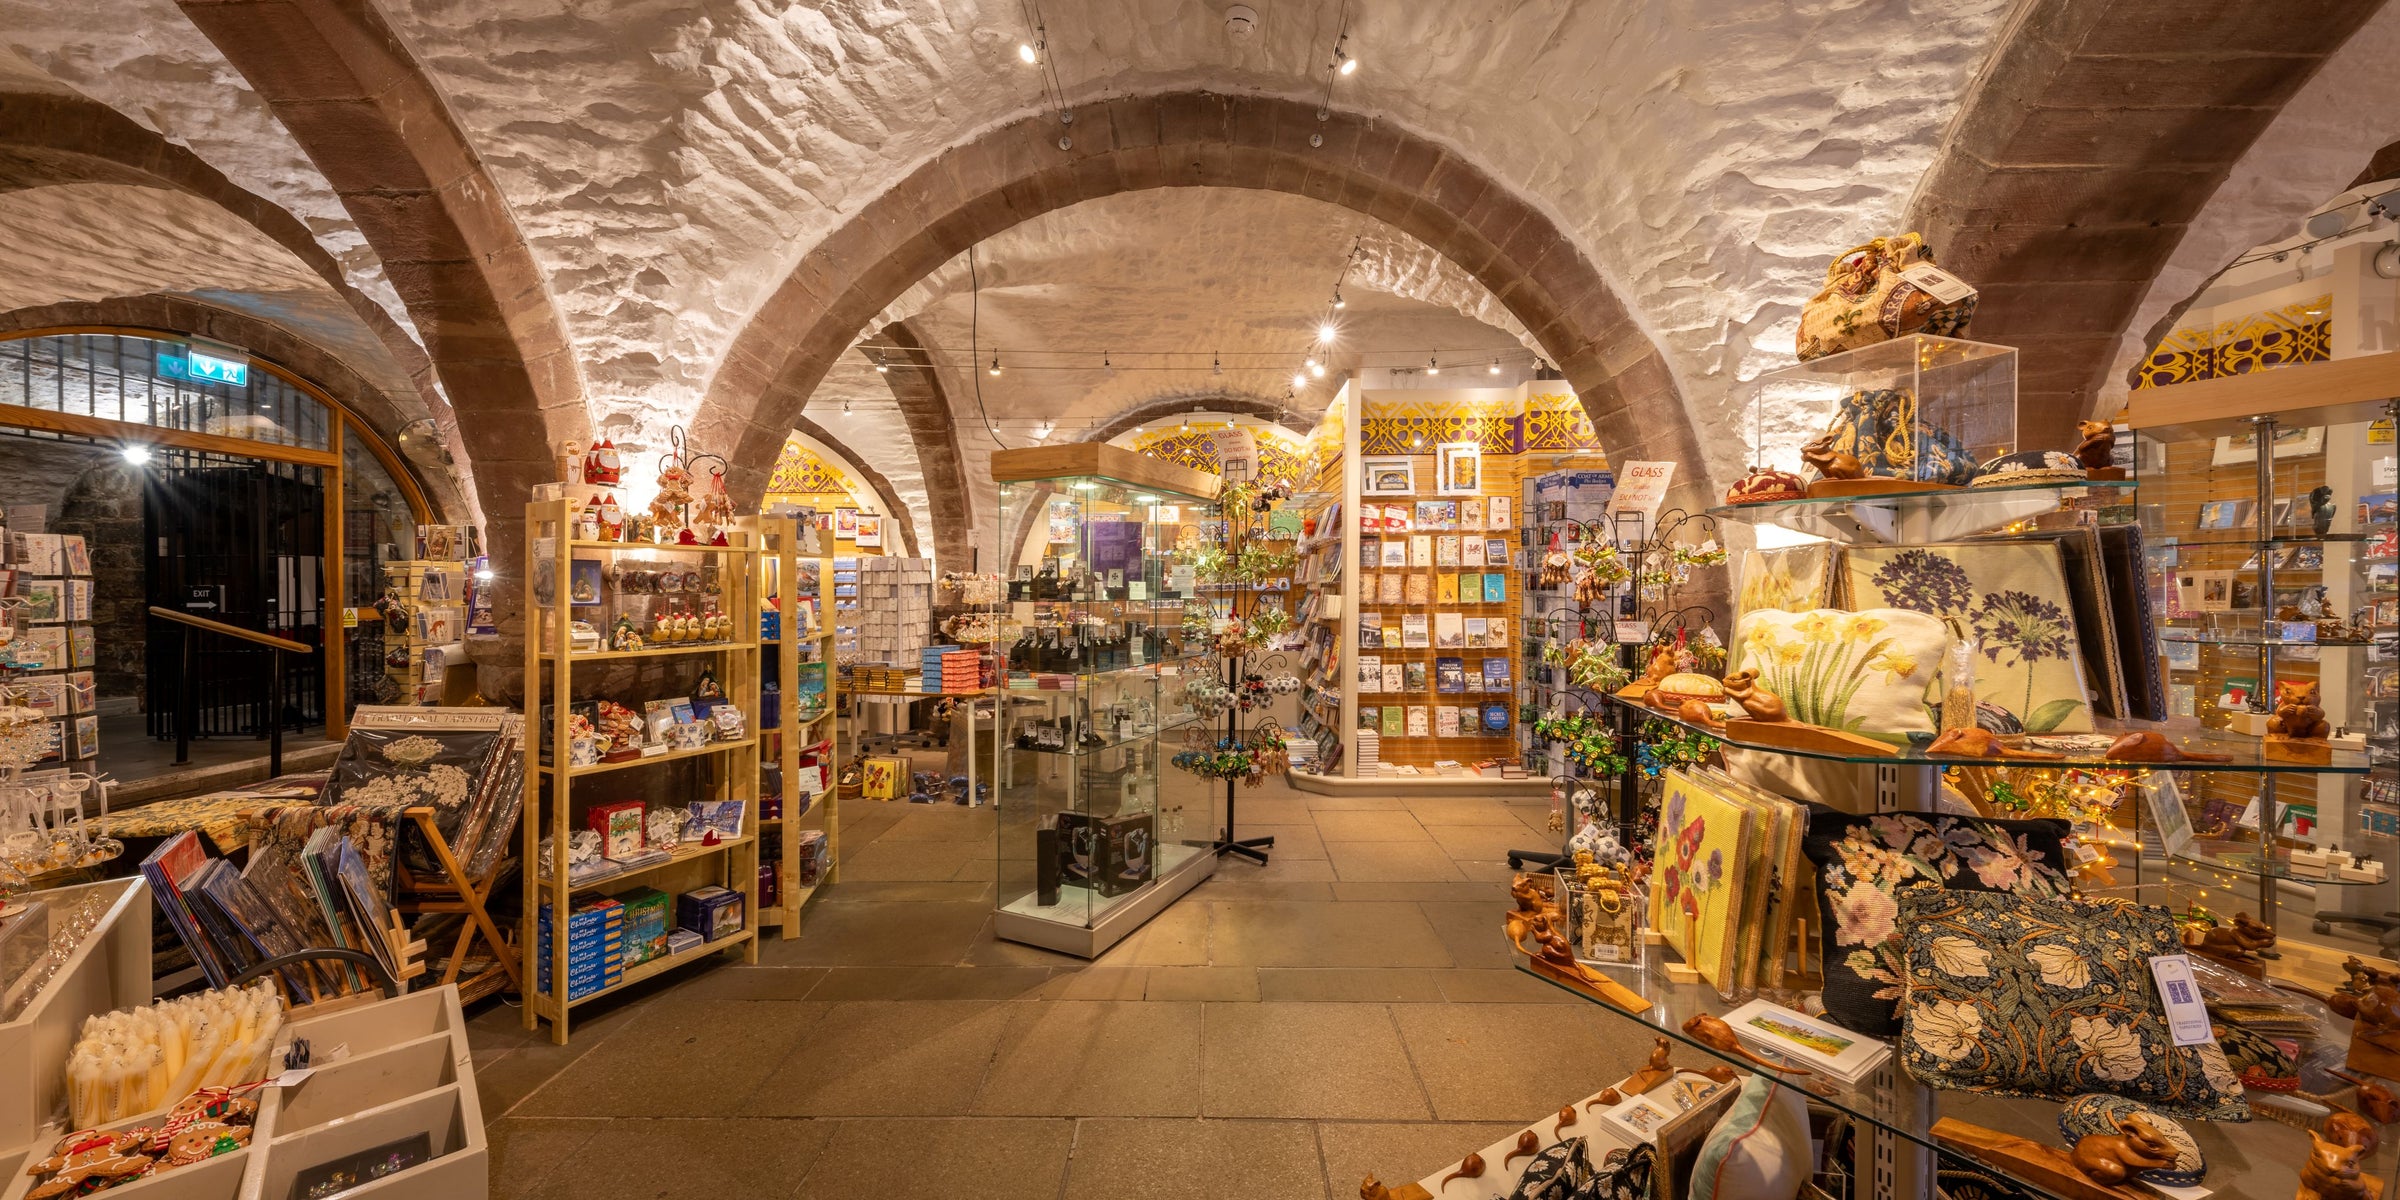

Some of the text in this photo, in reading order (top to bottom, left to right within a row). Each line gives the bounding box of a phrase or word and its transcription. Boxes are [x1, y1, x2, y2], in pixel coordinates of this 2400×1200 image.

[1218, 431, 1243, 439] GLASS
[1631, 466, 1665, 478] GLASS
[193, 590, 210, 598] EXIT
[444, 714, 500, 723] TAPESTRIES
